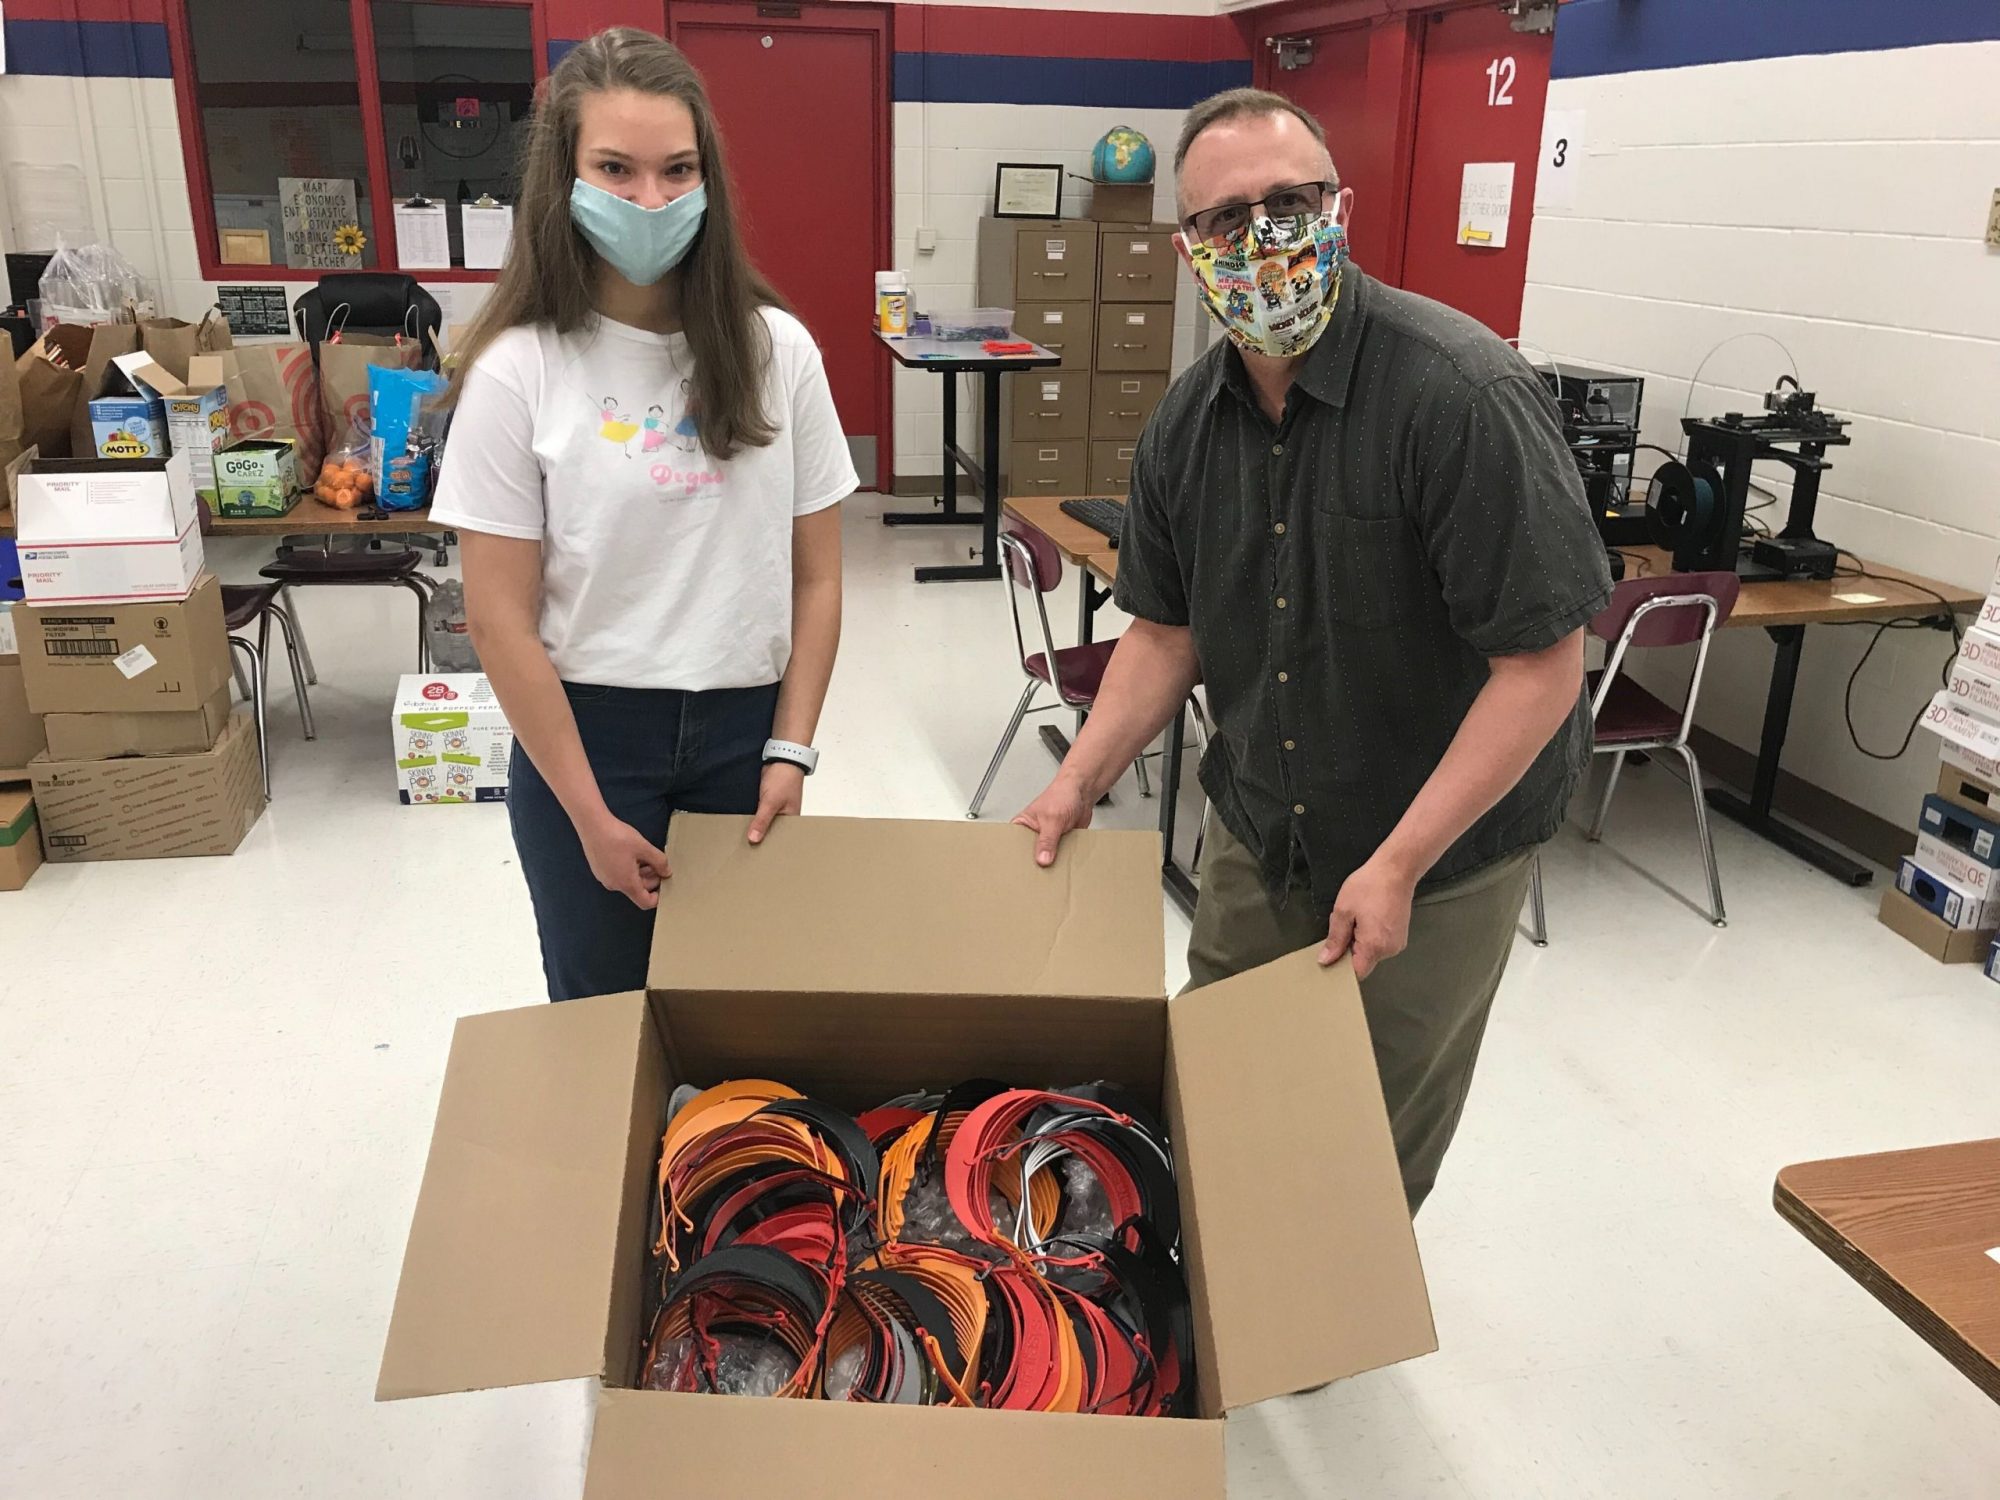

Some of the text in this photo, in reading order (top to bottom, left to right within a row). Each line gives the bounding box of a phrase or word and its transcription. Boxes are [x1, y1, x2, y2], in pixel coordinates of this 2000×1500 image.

[1486, 56, 1516, 106] 12
[1553, 138, 1568, 168] 3
[1961, 641, 1981, 660] 3D
[427, 686, 445, 694] 28
[1950, 677, 1970, 697] 3D
[1926, 704, 1948, 724] 3D
[407, 767, 434, 777] SKINNY
[447, 764, 474, 775] SKINNY
[1967, 867, 1986, 888] 3D
